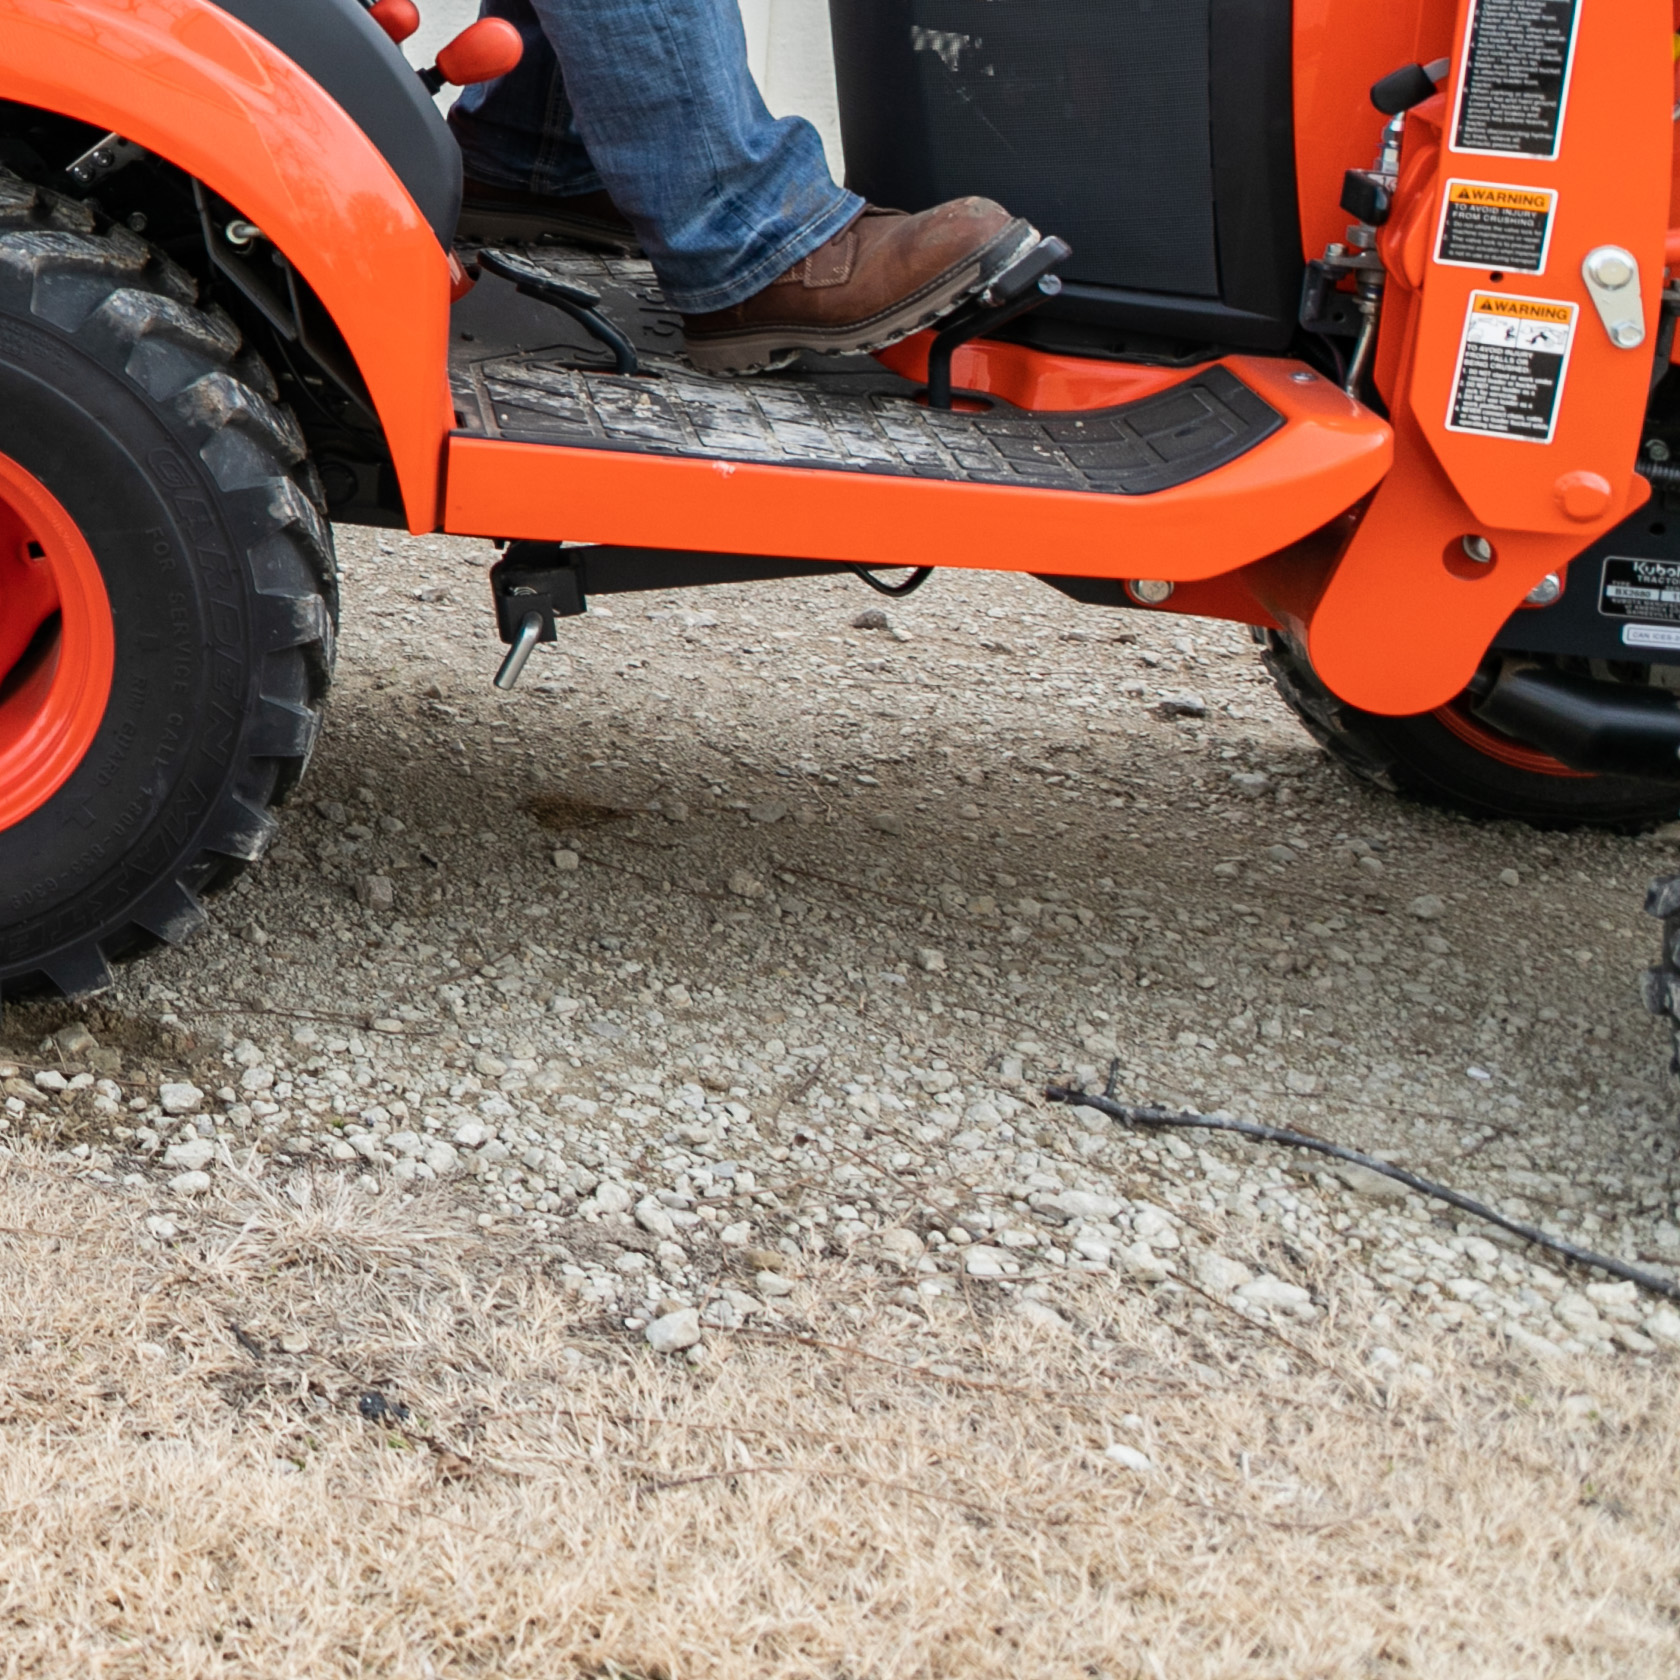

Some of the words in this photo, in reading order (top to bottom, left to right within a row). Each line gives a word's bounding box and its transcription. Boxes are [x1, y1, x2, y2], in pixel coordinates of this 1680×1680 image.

[1453, 212, 1480, 220] FROM
[1484, 215, 1534, 226] CRUSHING
[1469, 205, 1498, 213] AVOID
[1503, 209, 1536, 218] INJURY
[1472, 189, 1545, 206] WARNING
[1494, 301, 1567, 319] WARNING
[144, 523, 178, 573] FOR
[143, 438, 250, 769] GARDEN
[159, 590, 195, 696] SERVICE
[123, 675, 151, 714] RIM
[87, 717, 143, 790] GUARD
[146, 711, 189, 773] CALL
